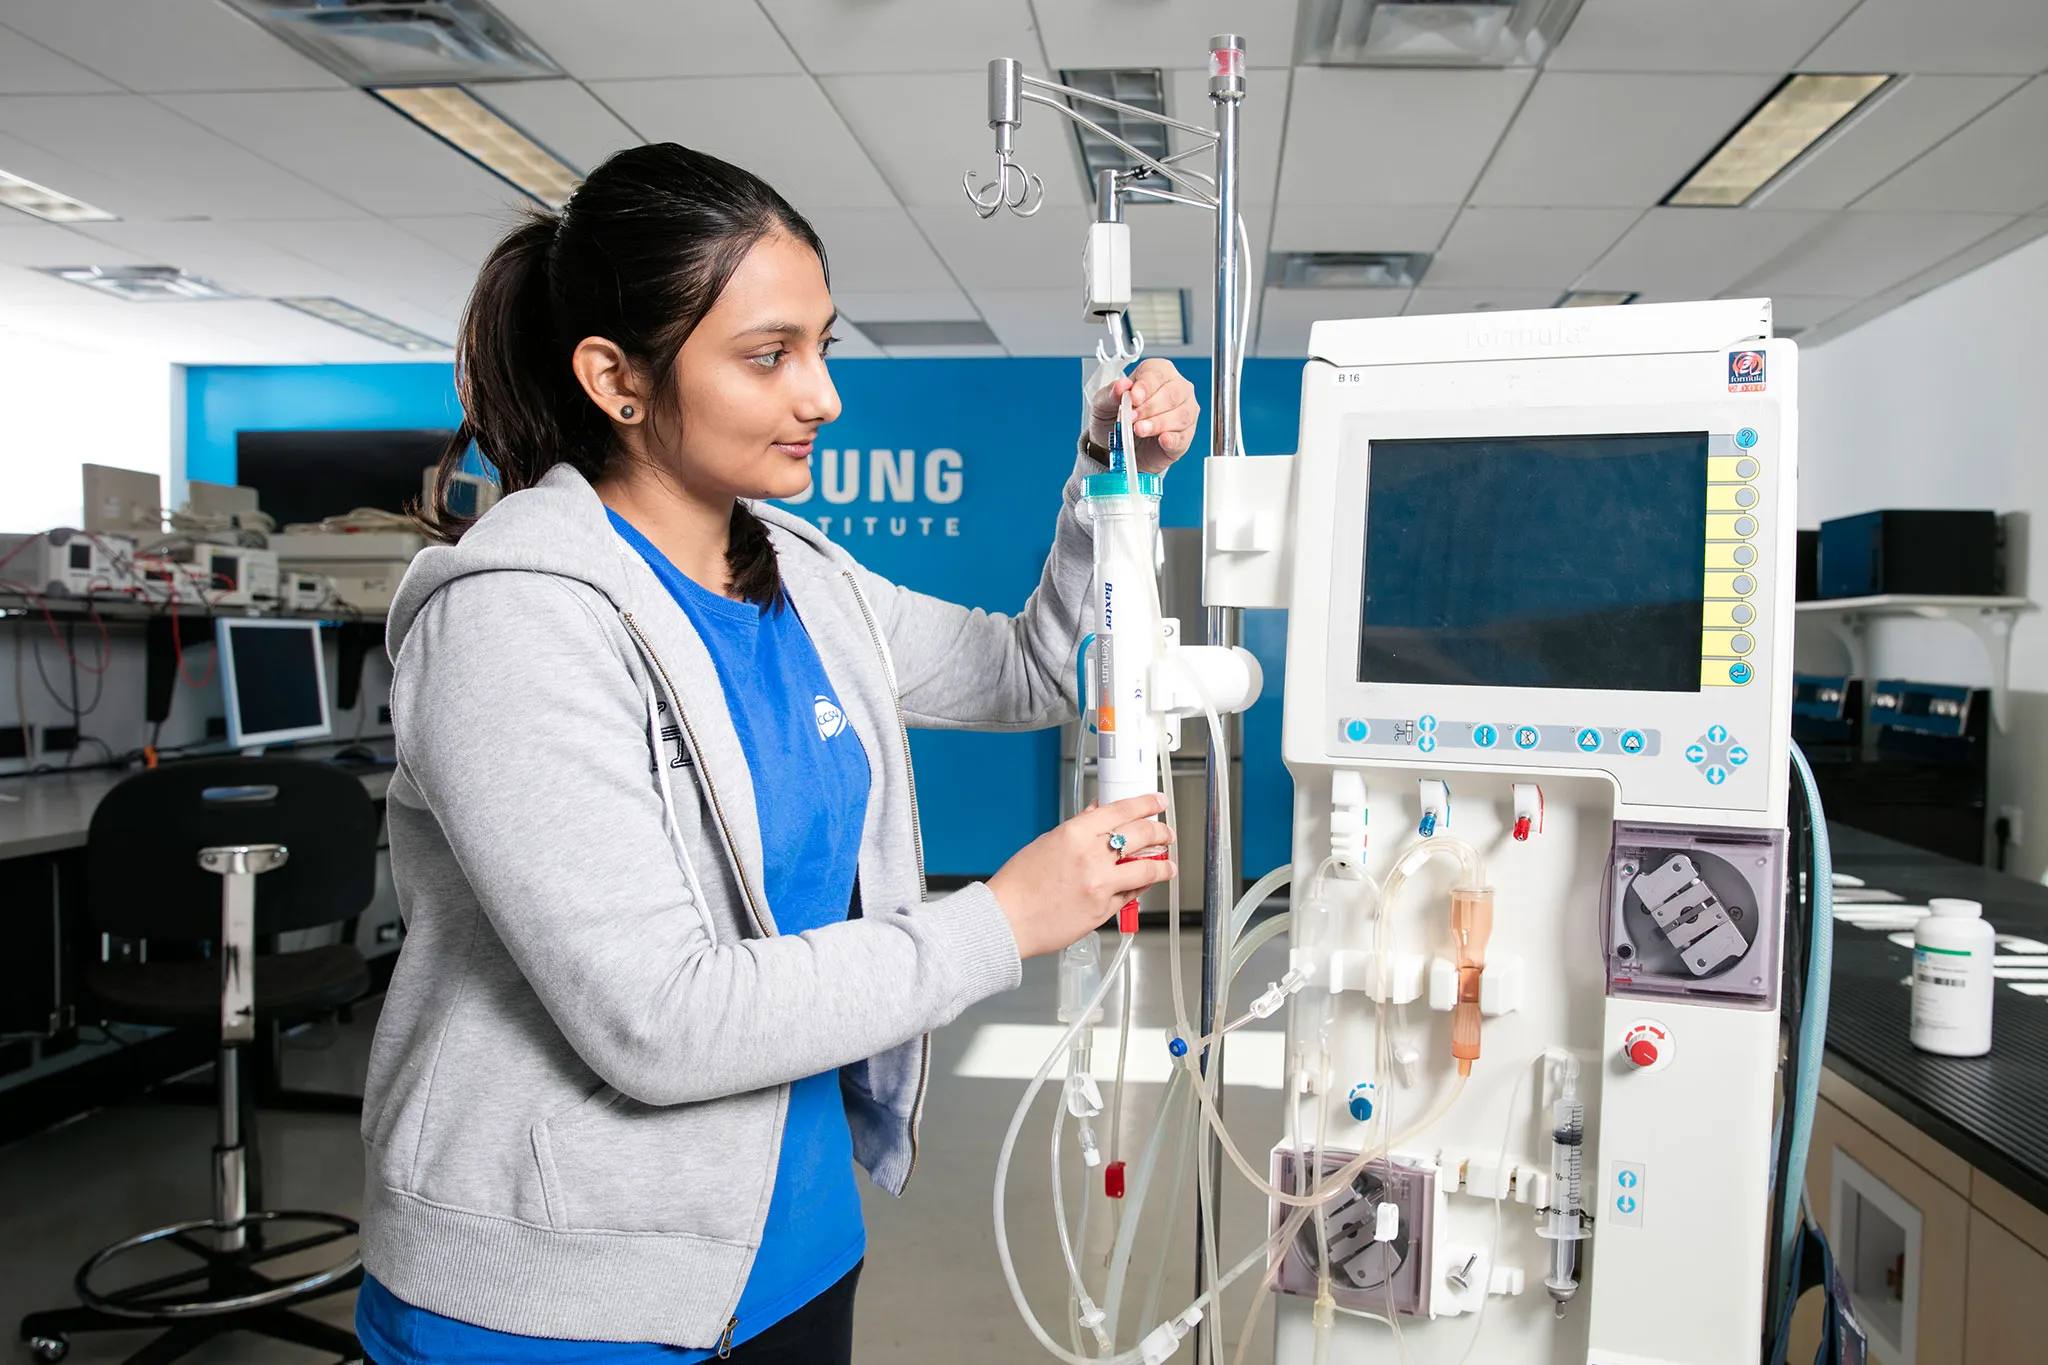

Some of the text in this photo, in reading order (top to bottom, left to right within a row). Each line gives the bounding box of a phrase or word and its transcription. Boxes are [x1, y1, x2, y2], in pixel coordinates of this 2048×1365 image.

[1338, 373, 1360, 383] B 16
[1104, 582, 1113, 630] Baxter
[1101, 638, 1112, 683] Xenium
